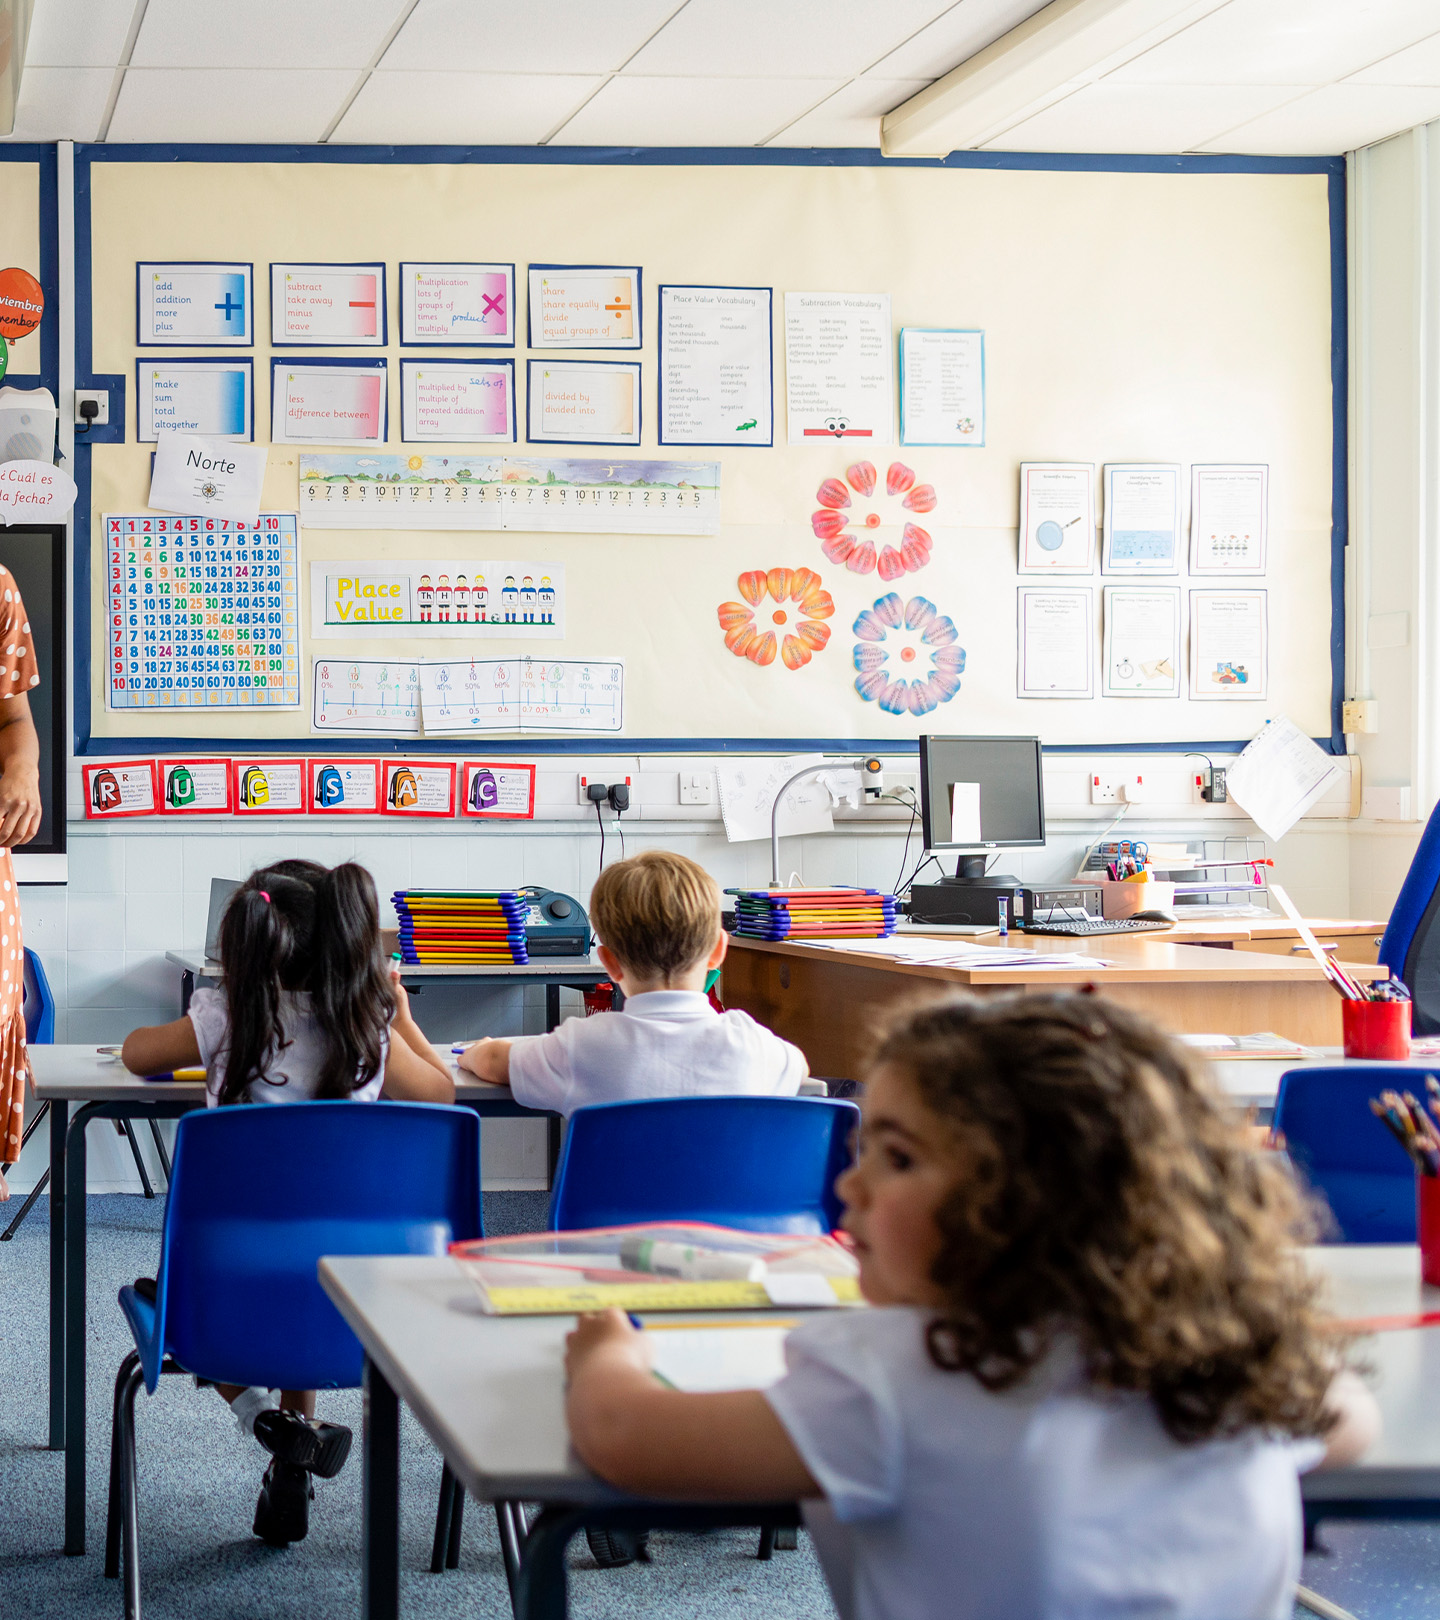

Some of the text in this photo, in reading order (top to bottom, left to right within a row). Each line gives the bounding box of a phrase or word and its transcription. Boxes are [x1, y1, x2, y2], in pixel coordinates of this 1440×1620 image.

[156, 282, 172, 290] add
[288, 283, 322, 291] subtract
[418, 278, 468, 287] multiplication
[434, 290, 442, 299] of
[542, 287, 565, 295] share
[156, 295, 191, 304] addition
[288, 296, 332, 307] take away
[717, 296, 756, 305] Vocabulary
[843, 300, 881, 309] Vocabulary
[418, 301, 453, 311] groups of
[543, 300, 599, 311] share equally
[288, 309, 313, 317] minus
[544, 313, 569, 322] divide
[452, 312, 487, 325] product
[156, 322, 173, 332] plus
[288, 322, 309, 330] leave
[418, 324, 448, 334] multiply
[544, 325, 610, 336] equal groups of
[155, 380, 178, 388] make
[419, 383, 467, 394] multiplied by
[155, 394, 172, 402] sum
[289, 395, 304, 404] less
[419, 394, 459, 405] multiple of
[545, 392, 590, 403] divided by
[155, 407, 175, 415] total
[288, 409, 370, 420] difference between
[419, 407, 485, 416] repeated addition
[545, 406, 595, 415] divided into
[155, 420, 198, 430] altogether
[419, 418, 439, 427] array
[186, 450, 236, 474] Norte
[0, 469, 52, 484] ¿Cuál es
[12, 491, 53, 505] fecha?
[337, 578, 400, 598] Place
[421, 592, 432, 600] Th
[441, 592, 448, 600] H
[477, 592, 484, 600] U
[526, 593, 531, 601] h
[542, 593, 551, 601] th
[335, 600, 403, 621] Value
[129, 676, 266, 689] 10 20 30 40 50 60 70 80 90
[100, 782, 117, 802] R
[174, 779, 192, 798] U
[249, 779, 265, 798] C
[326, 778, 339, 797] S
[398, 779, 415, 799] A
[478, 781, 494, 801] C
